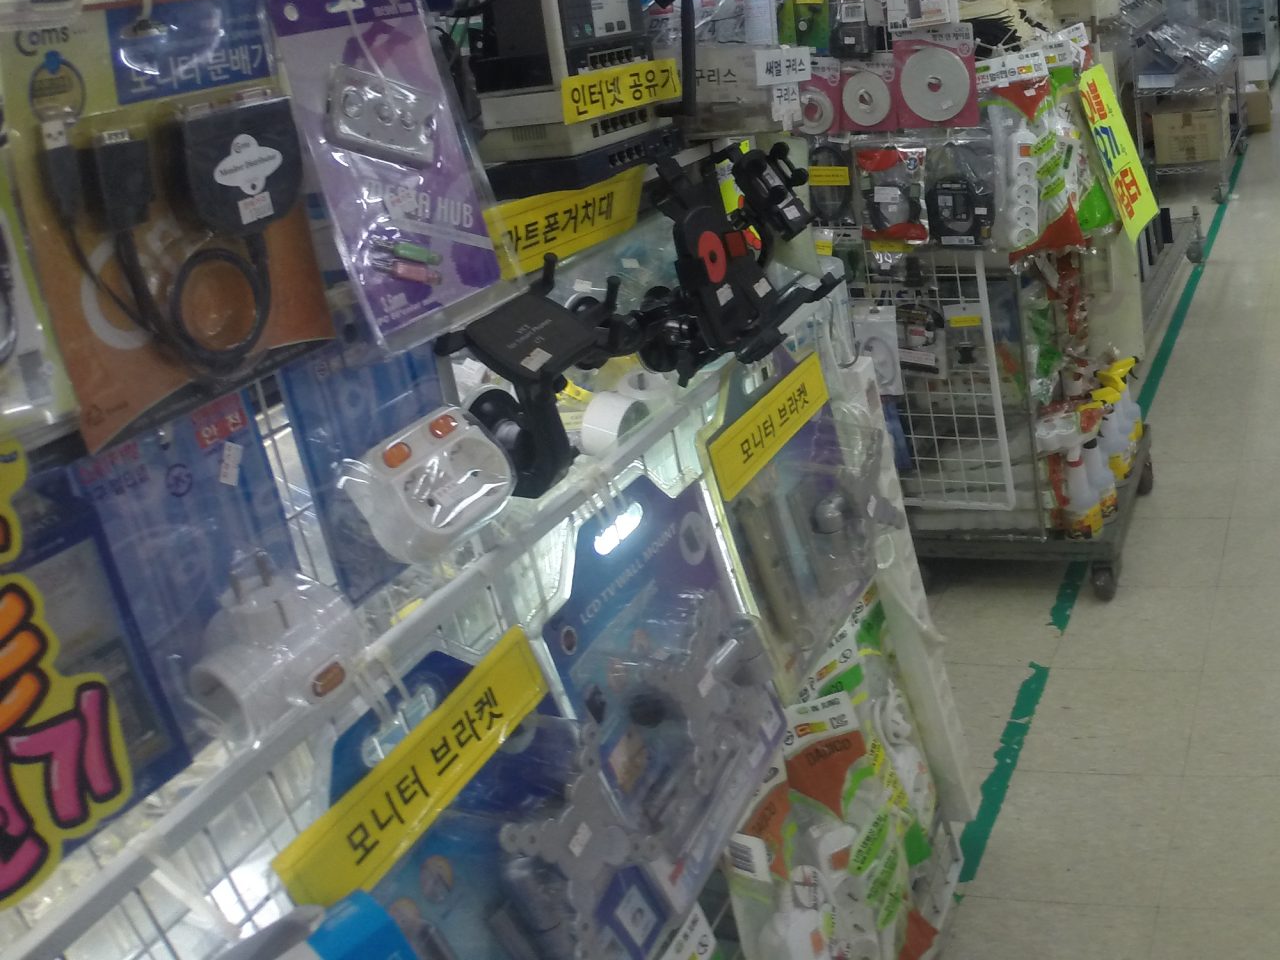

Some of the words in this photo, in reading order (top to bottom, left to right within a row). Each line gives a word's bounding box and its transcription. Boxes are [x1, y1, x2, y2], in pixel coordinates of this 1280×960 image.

[570, 76, 625, 117] 인터넷
[628, 66, 679, 102] 공유기
[437, 202, 475, 230] HUB
[739, 417, 777, 465] 모니터
[777, 382, 810, 427] 브라켓
[345, 764, 431, 867] 모니터
[430, 686, 504, 777] 브라켓
